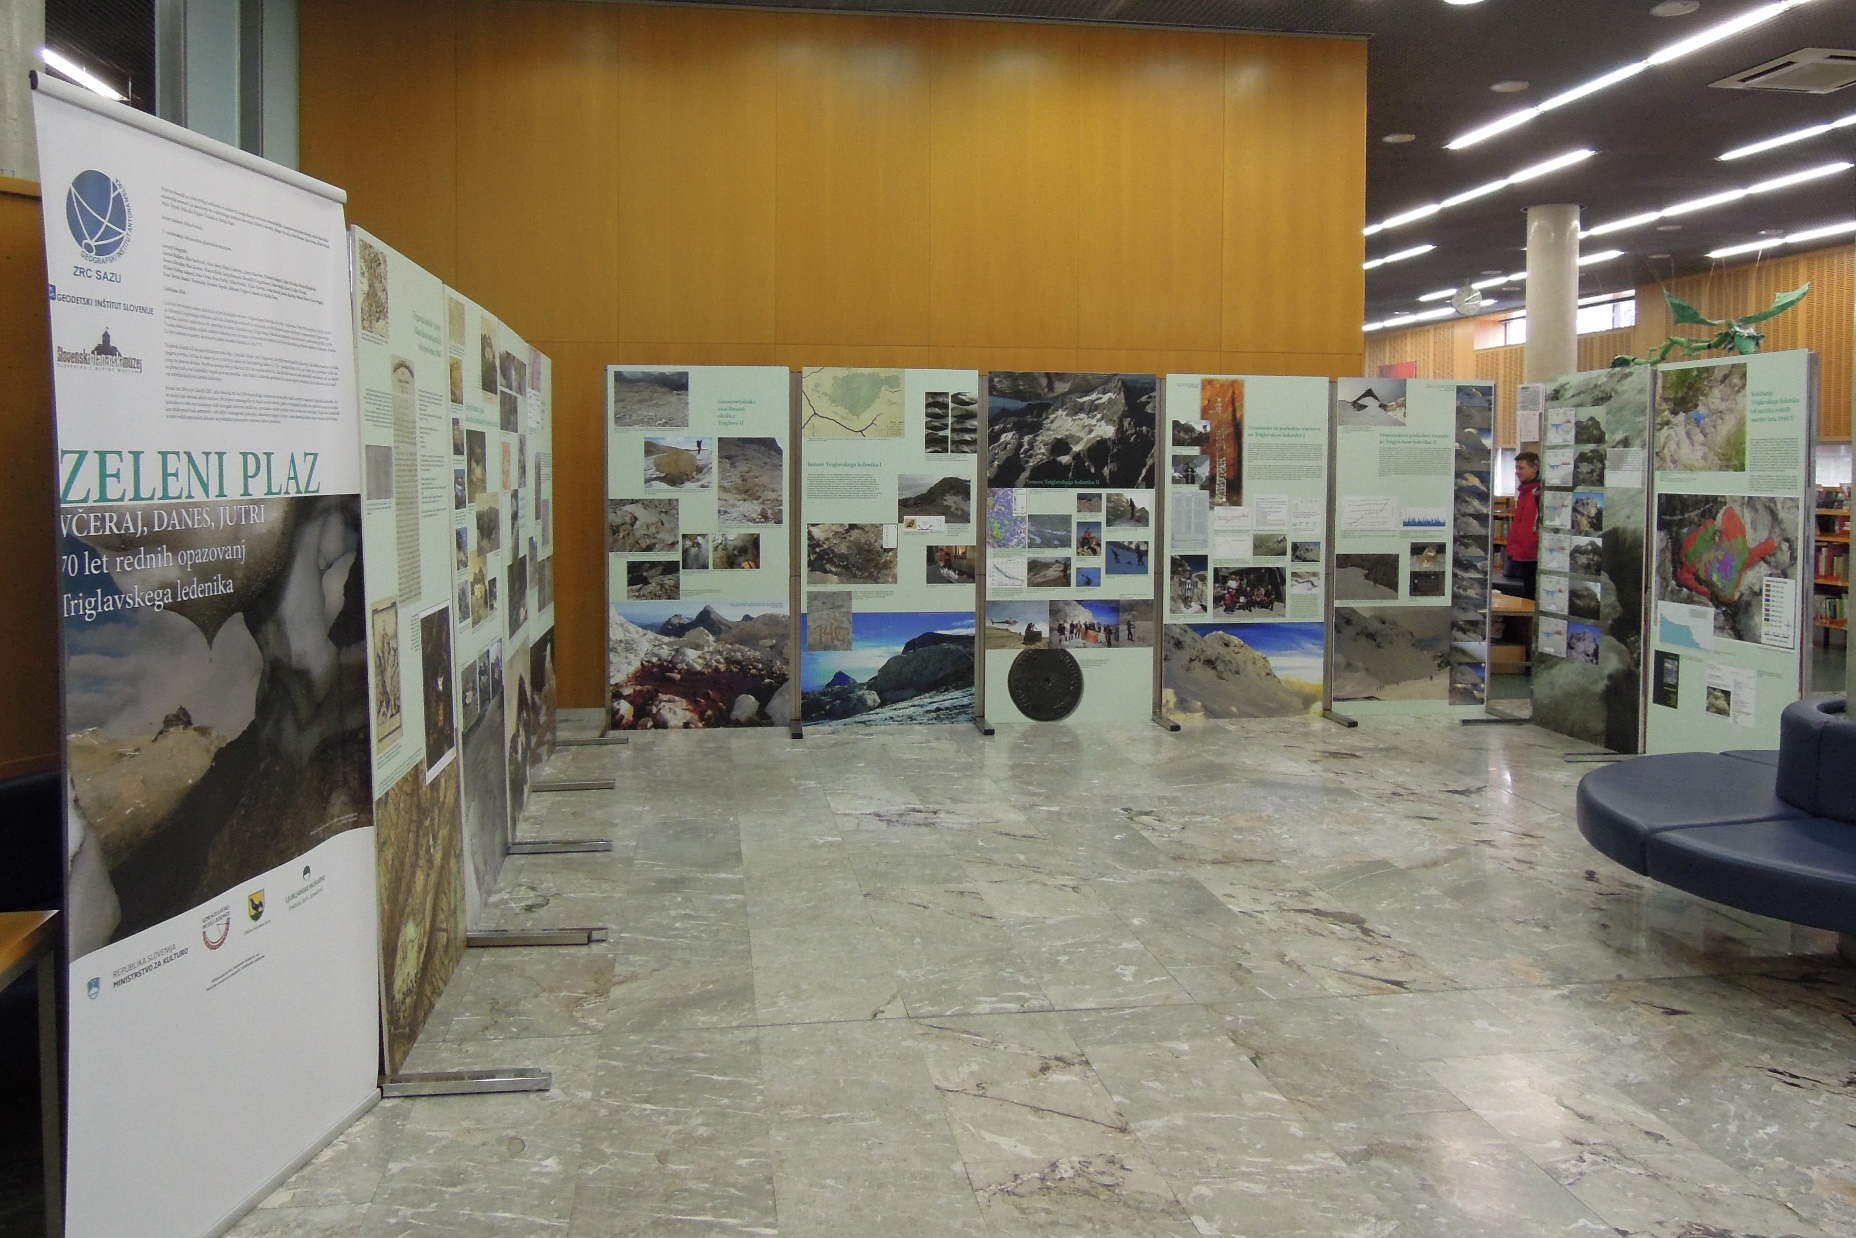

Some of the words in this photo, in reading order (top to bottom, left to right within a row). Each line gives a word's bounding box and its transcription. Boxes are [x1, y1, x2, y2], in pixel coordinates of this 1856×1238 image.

[73, 265, 93, 279] ZRC
[95, 269, 122, 283] SAZU
[56, 293, 93, 307] GEODETSKI
[122, 303, 154, 315] SLOVENIJE
[60, 448, 228, 504] ZELENI
[239, 451, 321, 497] PLAZ
[60, 508, 148, 538] VČERAJ,
[153, 506, 215, 532] DANES,
[218, 504, 266, 531] JUTRI
[61, 554, 78, 577] 70
[84, 550, 109, 575] let
[115, 545, 173, 572] rednih
[177, 539, 247, 572] opazovanj
[176, 573, 235, 602] ledenika
[112, 964, 154, 988] MINISTRSTVO
[153, 959, 162, 969] ZA
[162, 947, 189, 965] KULTURO
